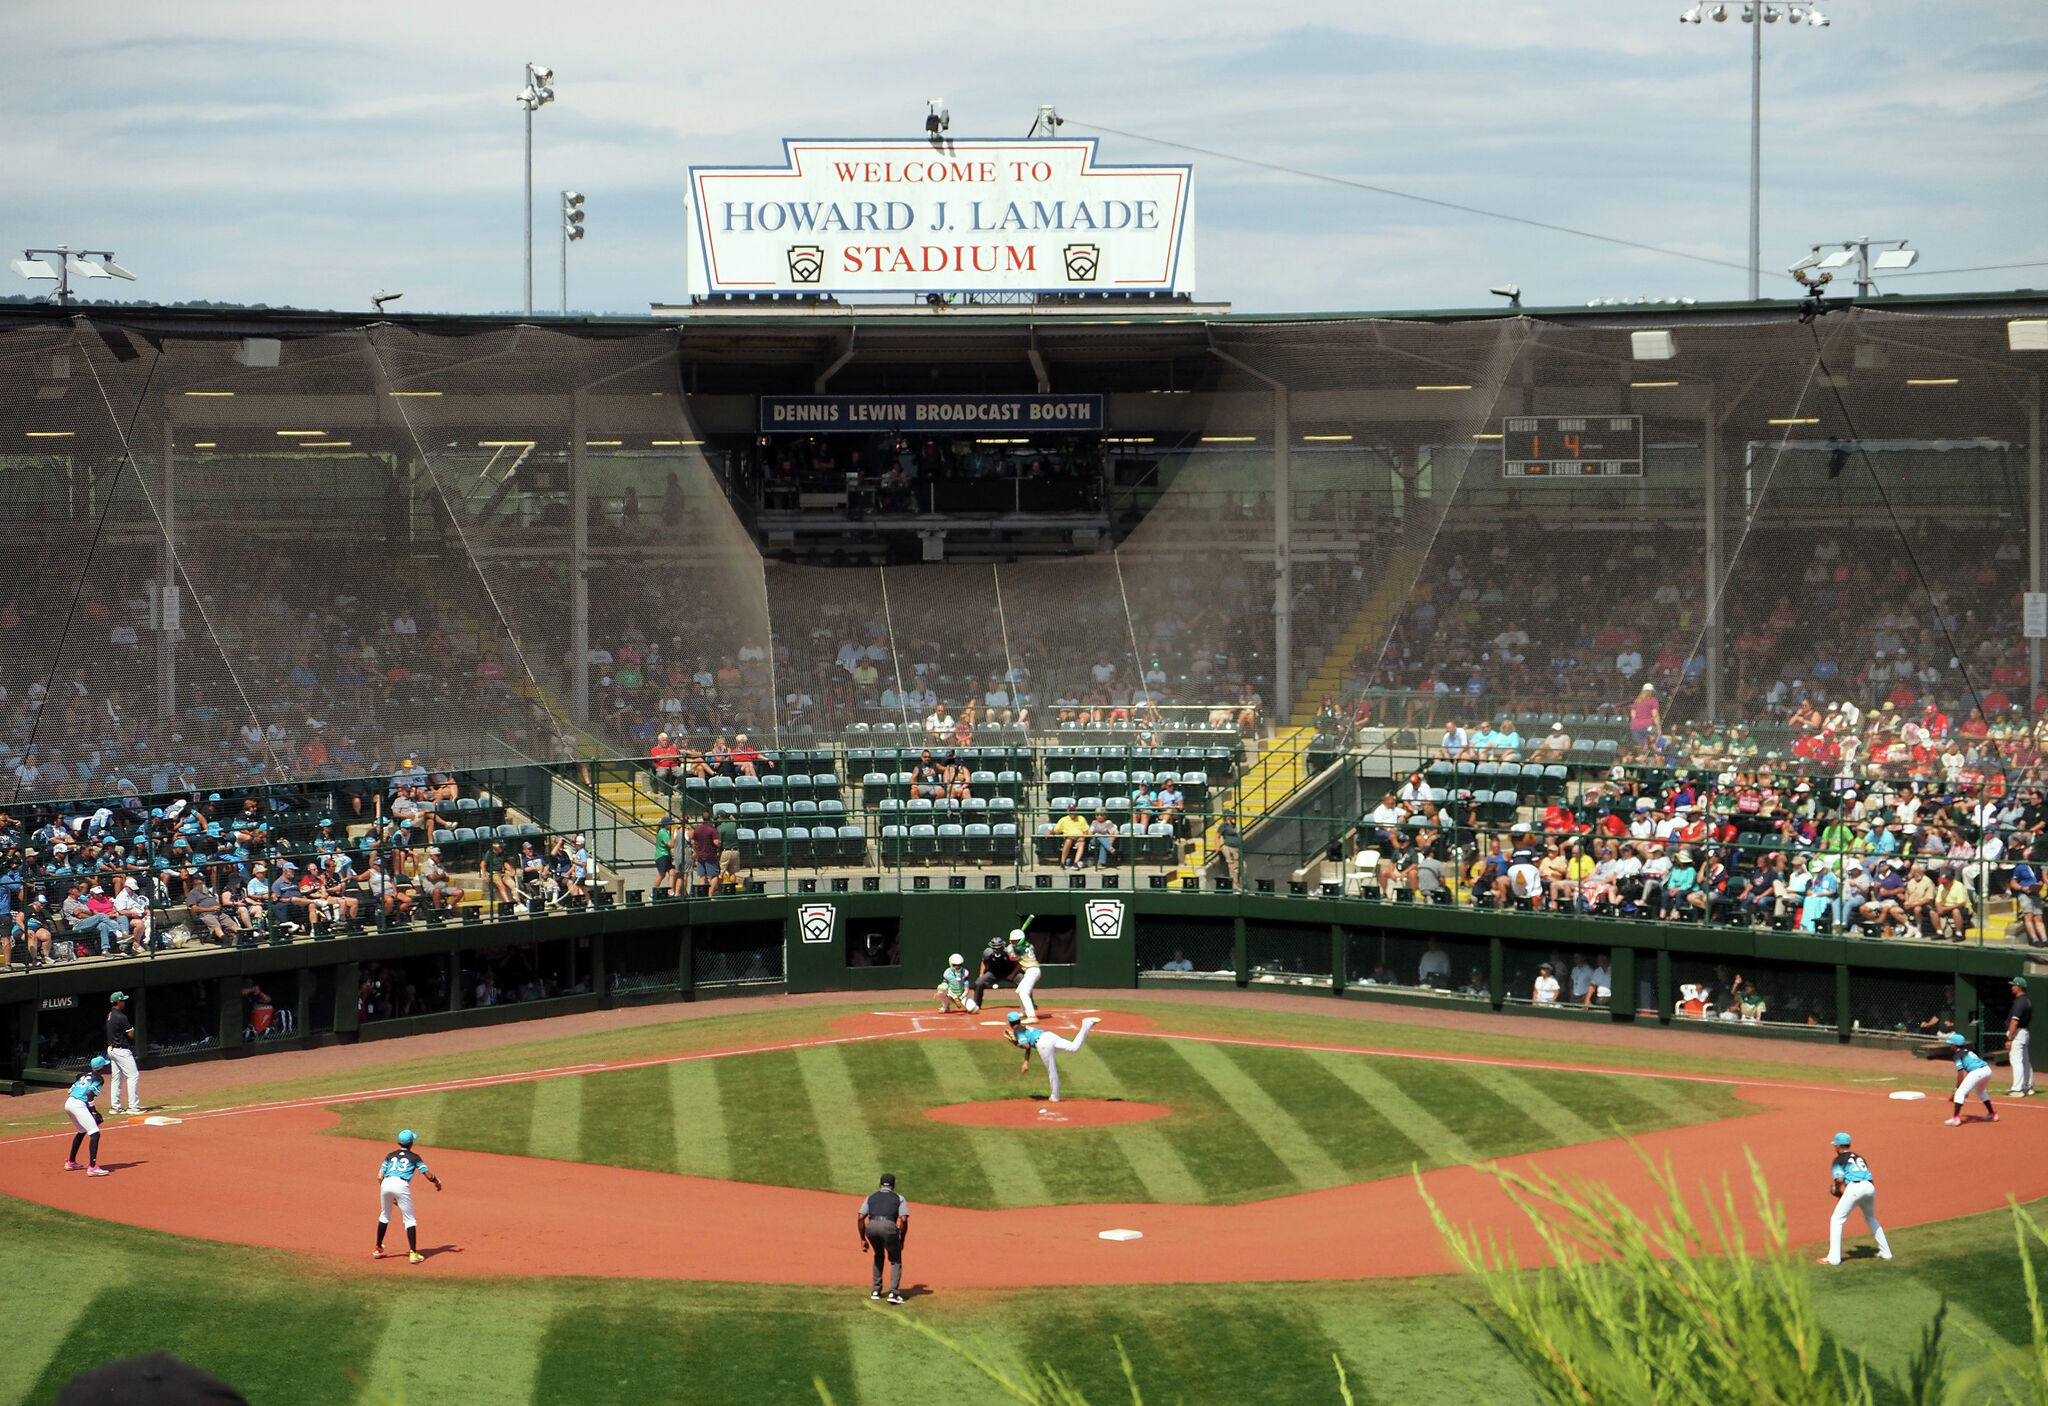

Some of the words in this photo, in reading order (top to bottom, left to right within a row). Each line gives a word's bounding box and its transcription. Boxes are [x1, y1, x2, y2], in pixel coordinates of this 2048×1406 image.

[835, 162, 997, 183] WELCOME
[1011, 161, 1052, 182] TO
[724, 202, 914, 231] HOWARD
[931, 202, 953, 231] J.
[972, 201, 1159, 231] LAMADE
[843, 245, 1037, 273] STADIUM
[774, 404, 839, 421] DENNIS
[849, 404, 906, 421] LEWIN
[916, 403, 1021, 421] BROADCAST
[1029, 403, 1090, 420] BOOTH
[1533, 435, 1539, 457] 1
[1564, 434, 1579, 457] 4
[42, 996, 73, 1009] #LLWS
[390, 1157, 409, 1171] 13
